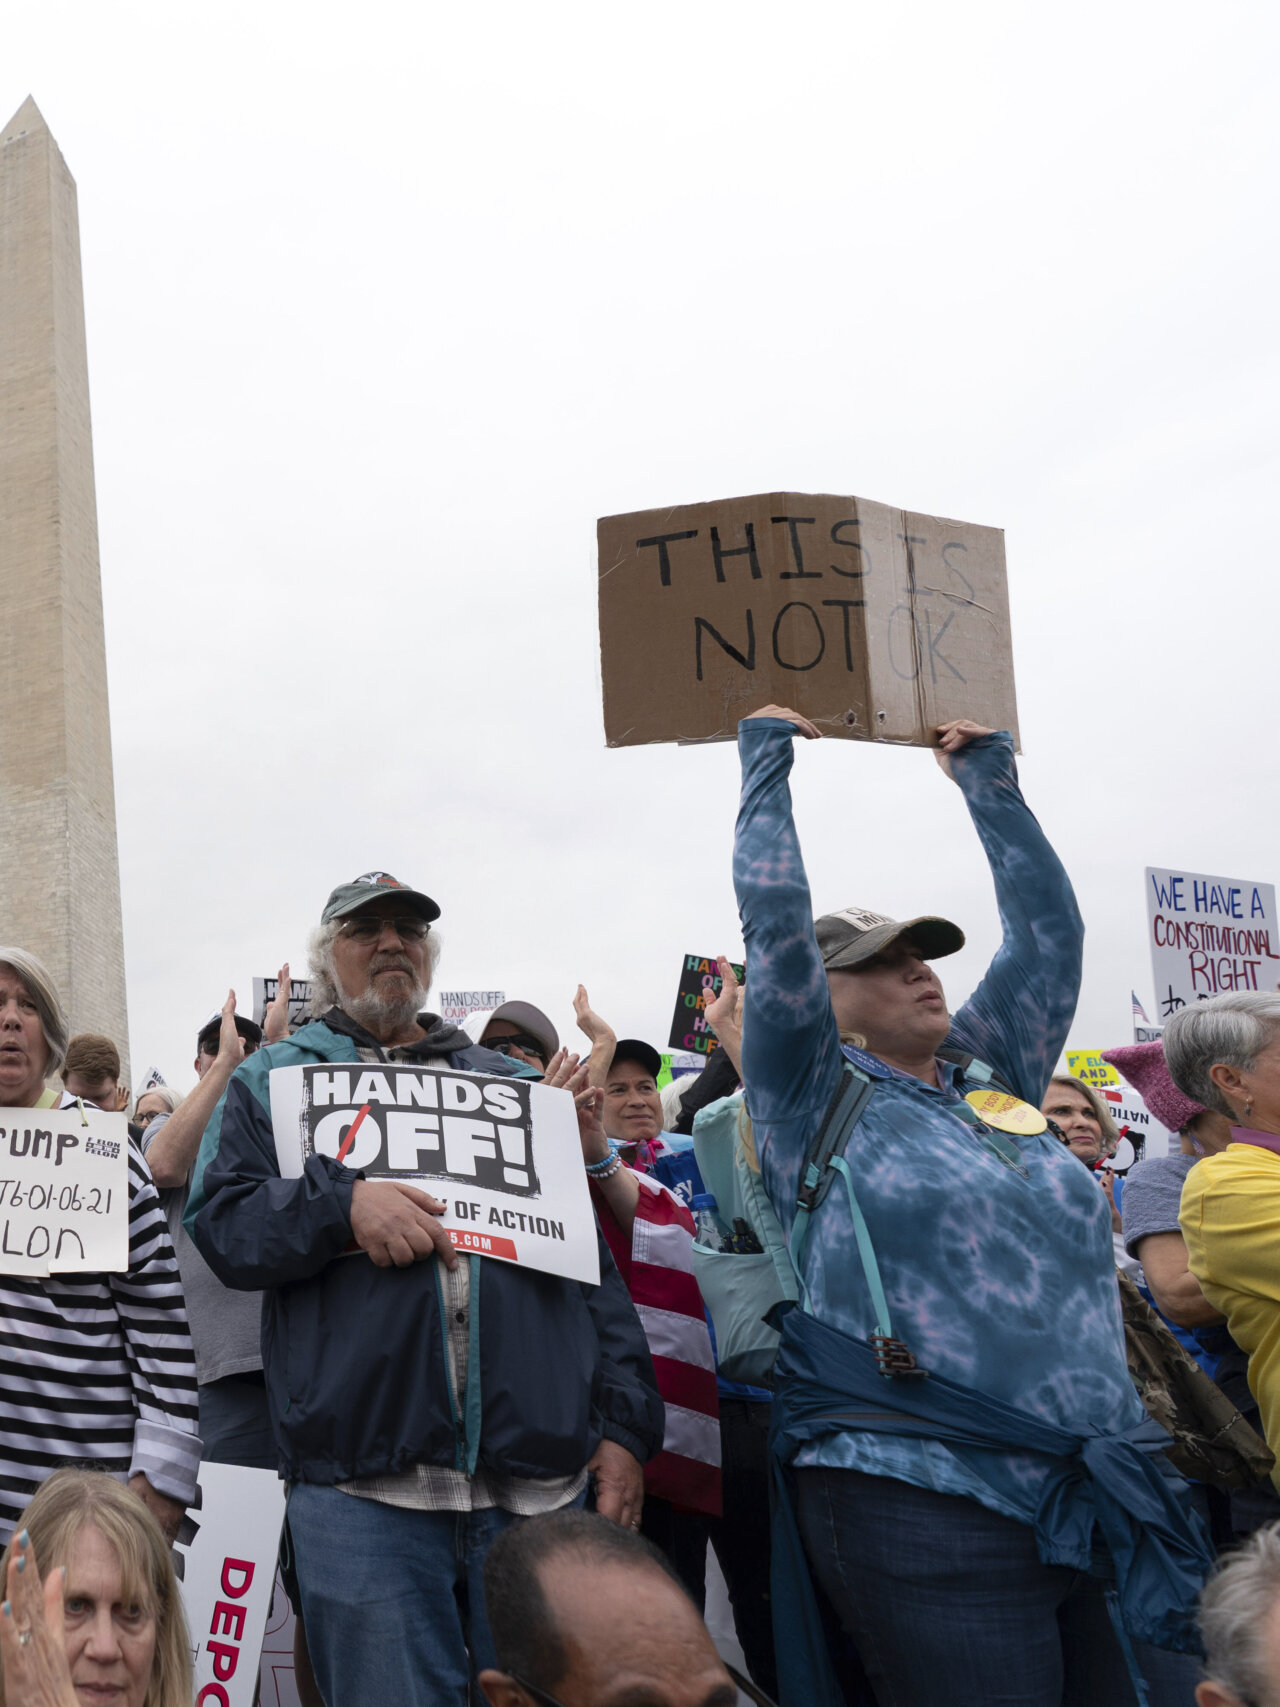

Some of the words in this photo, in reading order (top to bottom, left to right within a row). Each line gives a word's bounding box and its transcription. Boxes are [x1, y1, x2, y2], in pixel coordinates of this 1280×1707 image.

[636, 516, 872, 586] THIS
[896, 532, 977, 607] IS
[694, 600, 867, 682] NOT
[888, 605, 967, 684] OK
[1151, 874, 1186, 912] WE
[1193, 880, 1244, 919] HAVE
[1251, 887, 1266, 919] A
[686, 956, 743, 980] HANS
[701, 974, 723, 991] OF
[1188, 950, 1262, 993] RIGHT
[440, 991, 480, 1007] HANDS
[684, 1033, 722, 1054] CUF
[1079, 1068, 1107, 1079] AND
[313, 1071, 522, 1120] HANDS
[314, 1109, 529, 1188] OFF!
[455, 1200, 481, 1222] OF
[488, 1206, 566, 1242] ACTION
